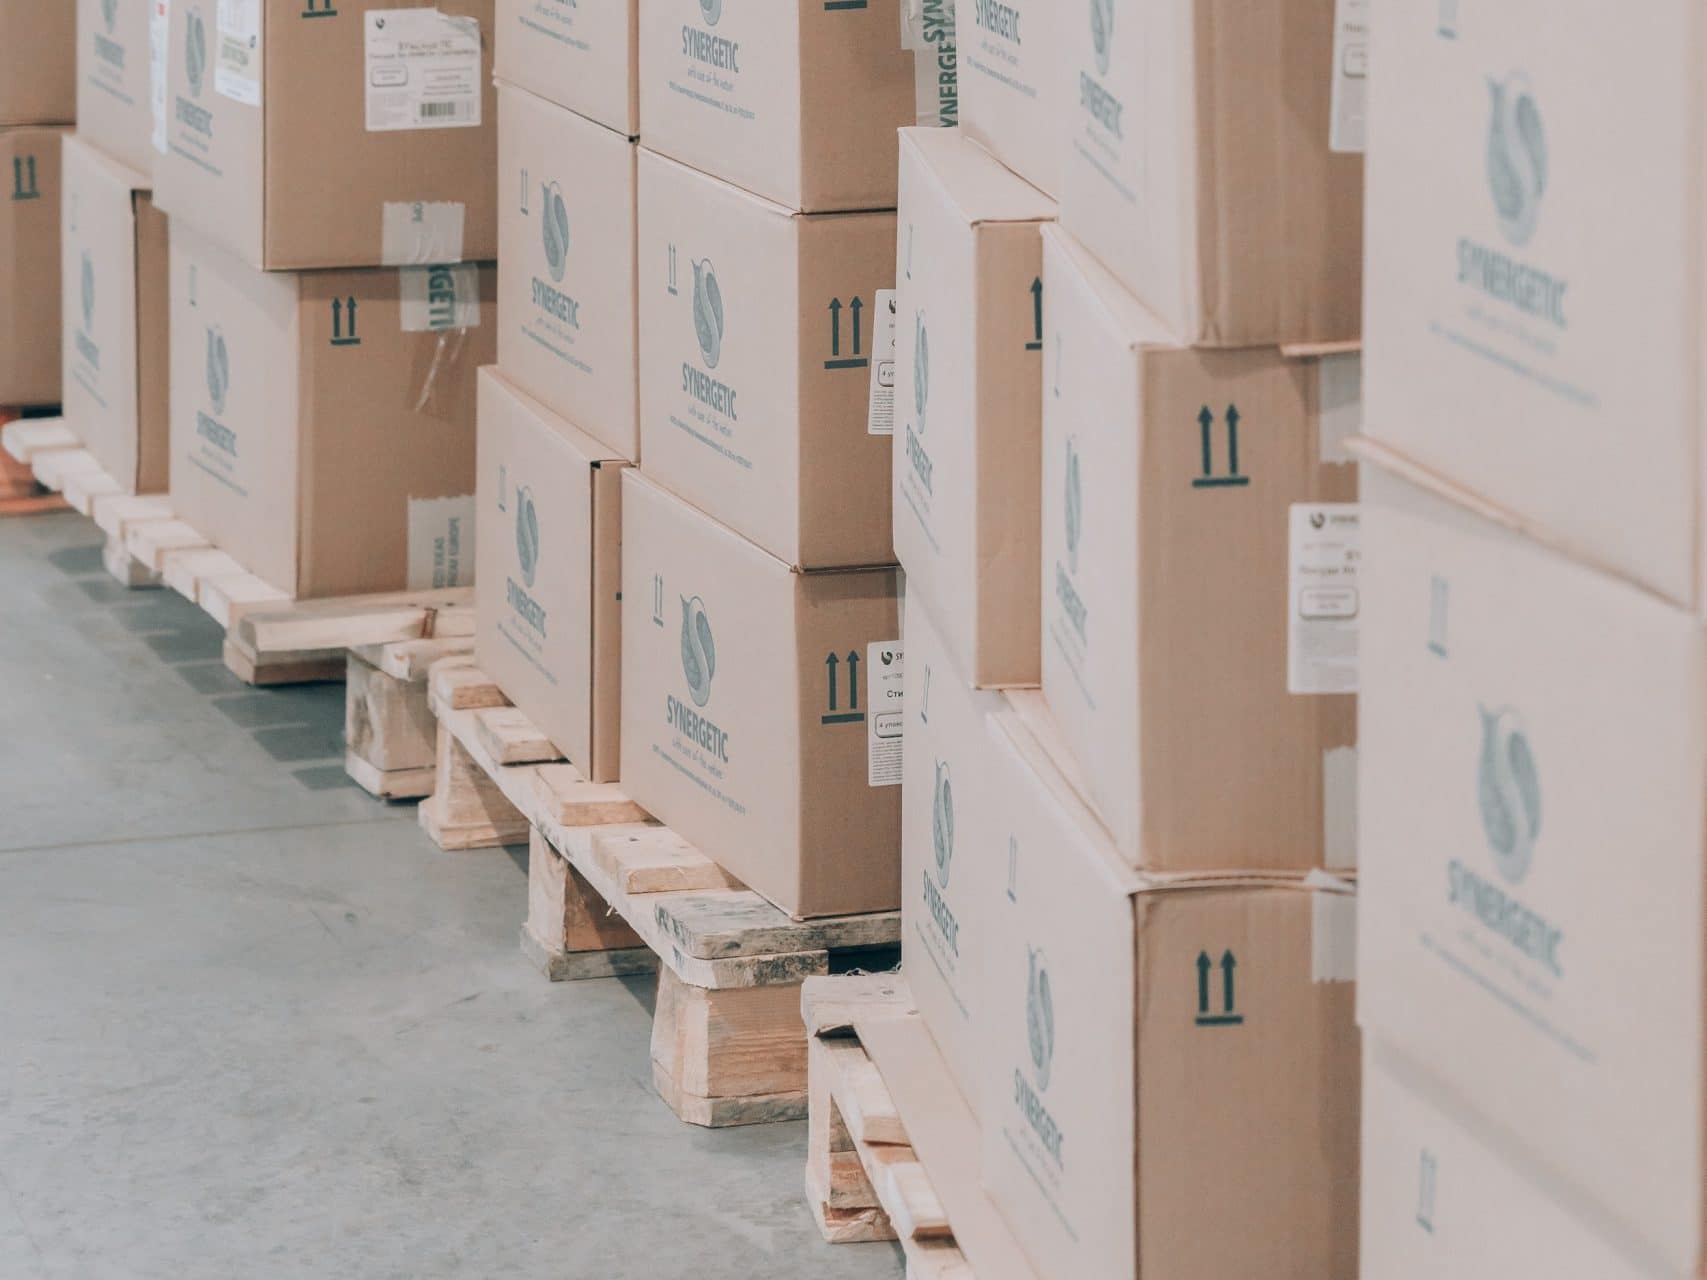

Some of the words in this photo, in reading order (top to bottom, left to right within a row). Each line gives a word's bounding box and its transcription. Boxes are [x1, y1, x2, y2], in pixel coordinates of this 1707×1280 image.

[682, 24, 740, 74] SYNERGETIC
[531, 276, 579, 330] SYNERGETIC
[682, 361, 737, 421] SYNERGETIC
[667, 694, 728, 764] SYNERGETIC
[923, 868, 959, 959] SYNERGETIC
